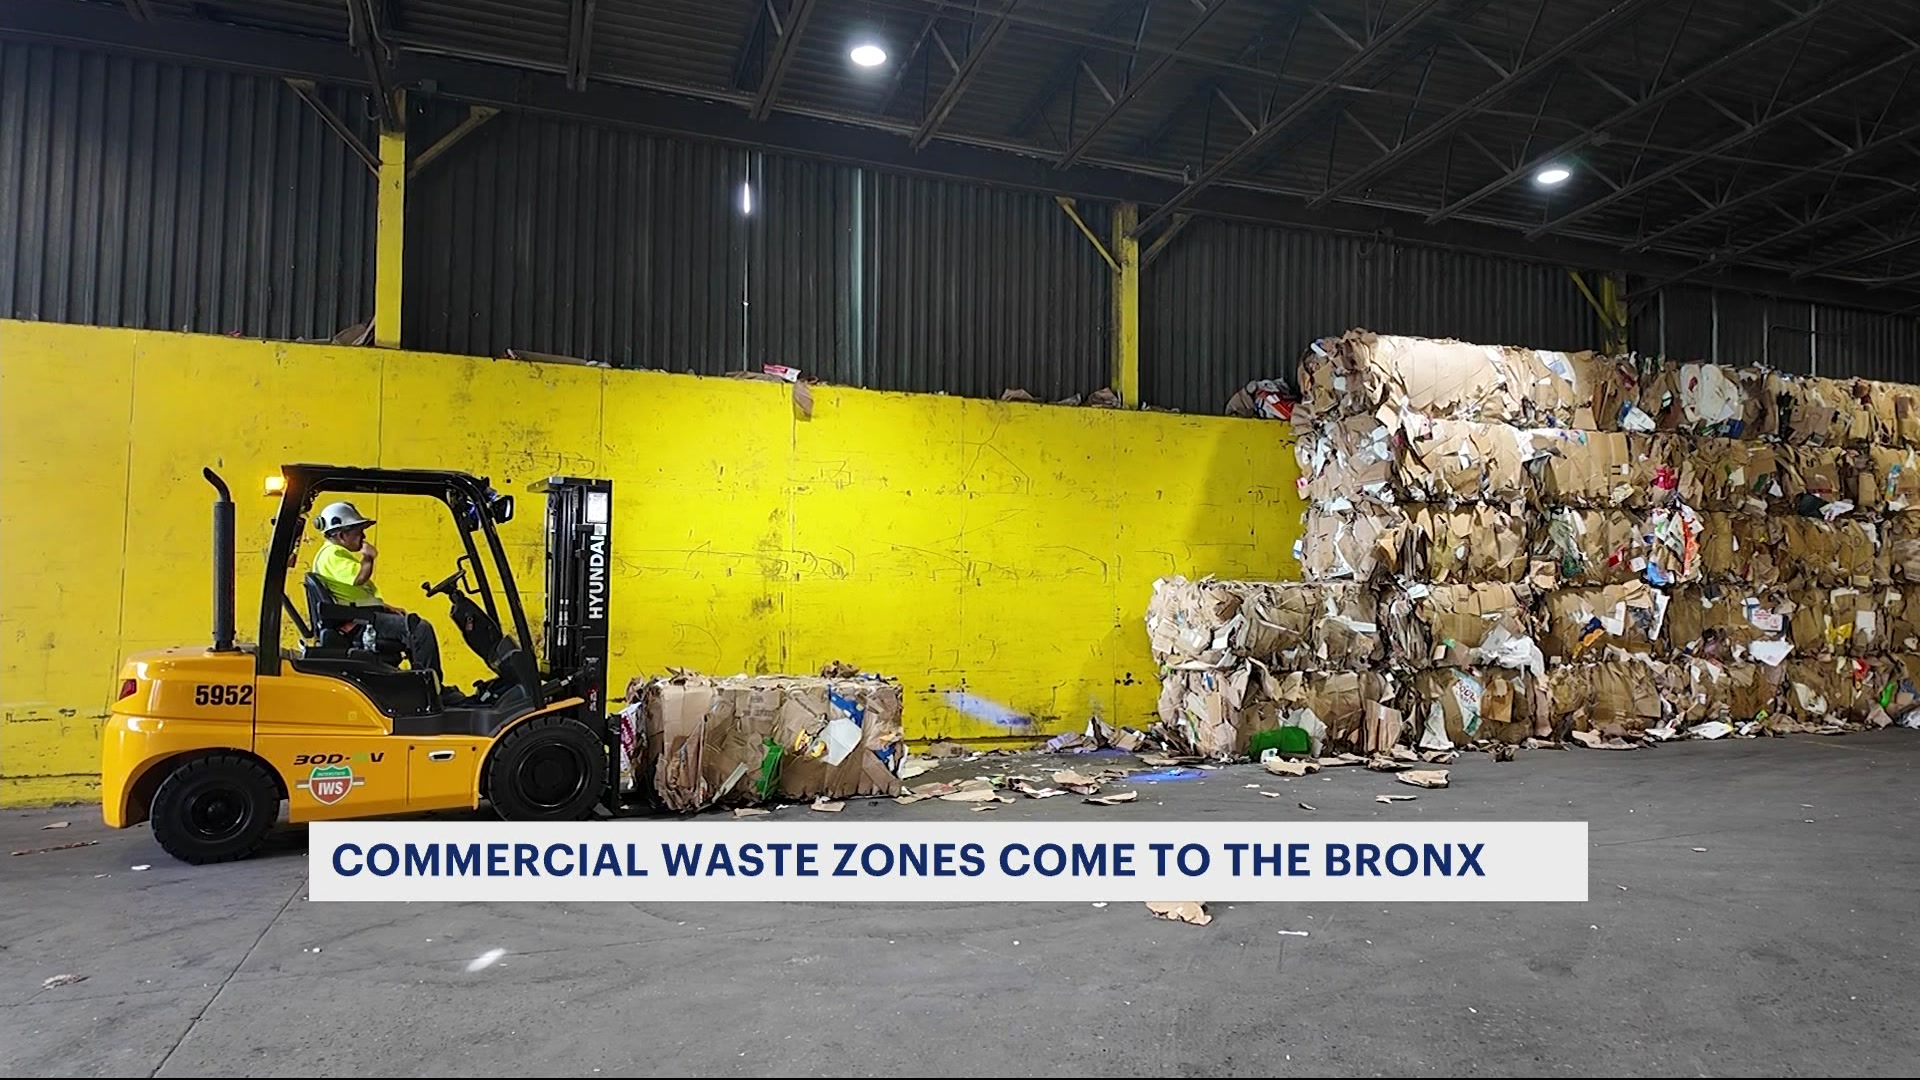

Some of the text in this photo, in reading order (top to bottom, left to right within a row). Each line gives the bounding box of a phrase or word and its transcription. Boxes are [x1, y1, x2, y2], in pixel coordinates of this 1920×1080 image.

[589, 536, 604, 618] HYUNDAI
[195, 685, 252, 705] 5952
[318, 782, 343, 795] IWS
